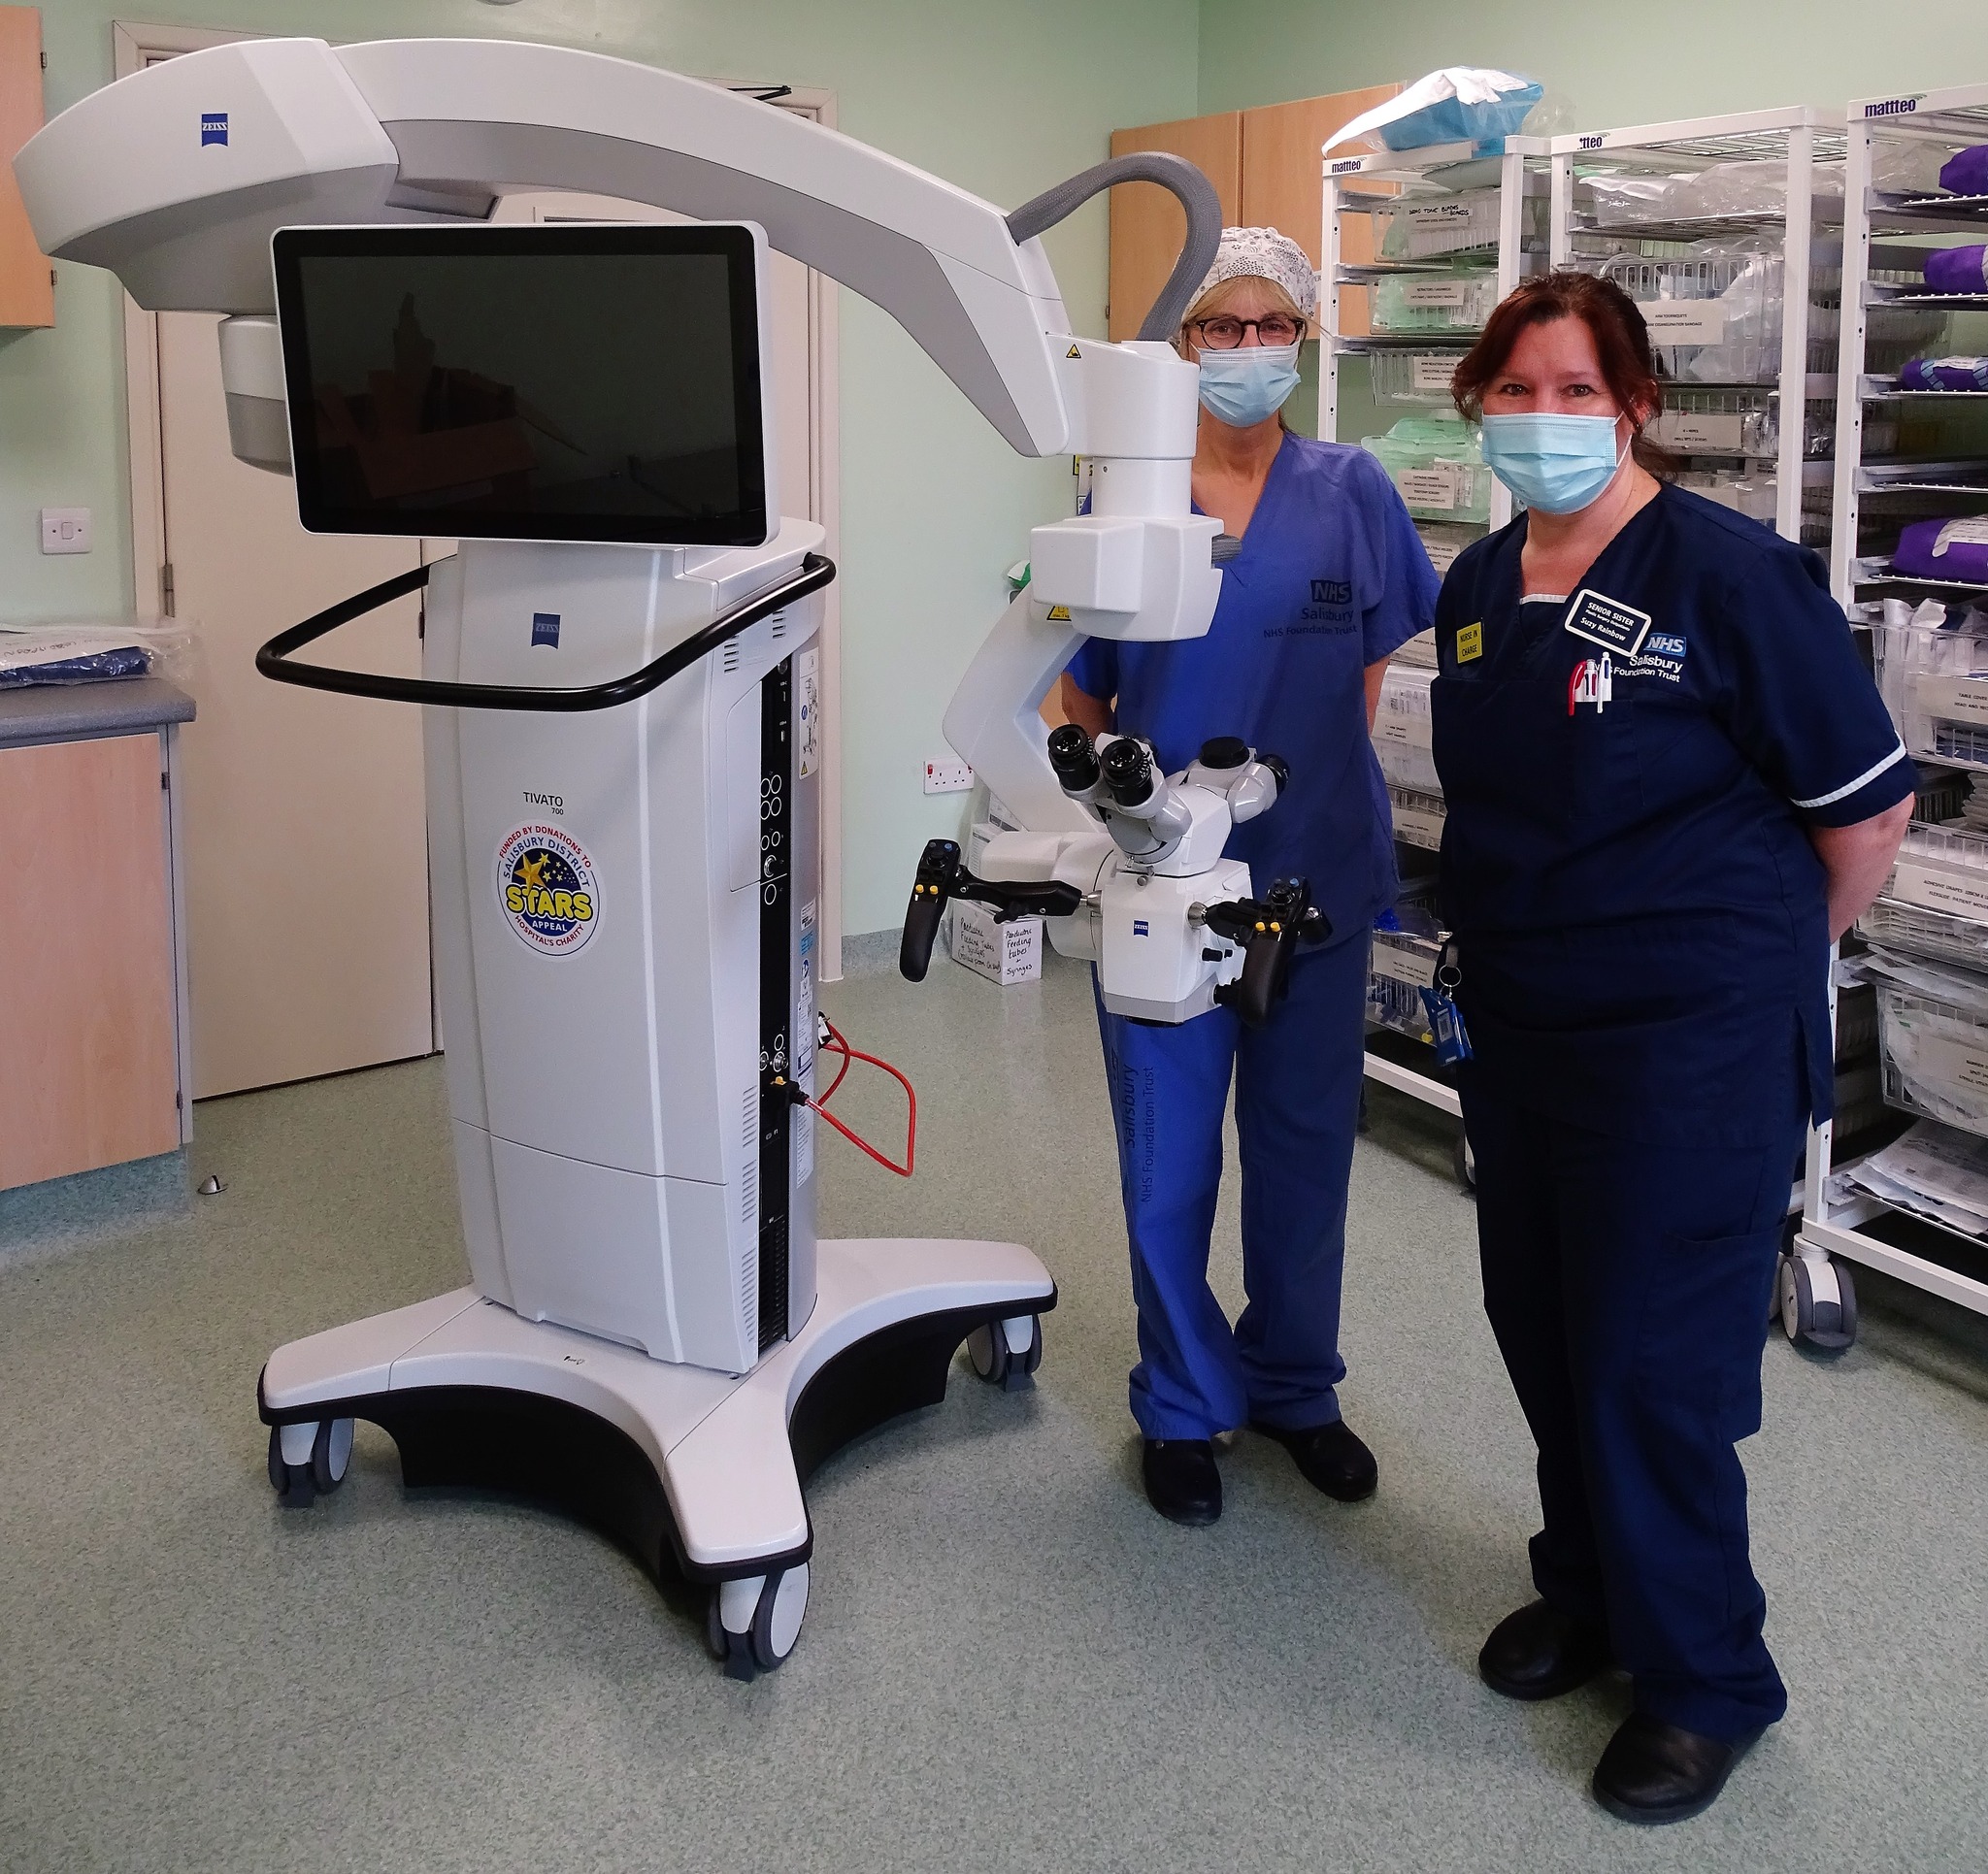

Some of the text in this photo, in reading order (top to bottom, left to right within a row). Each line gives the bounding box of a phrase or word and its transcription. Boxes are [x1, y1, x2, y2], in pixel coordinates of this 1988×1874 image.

[1865, 99, 1916, 117] mattteo
[203, 122, 228, 131] ZEISS
[1332, 160, 1362, 174] mattteo
[1313, 582, 1350, 603] NHS
[1301, 608, 1354, 623] Salisbury
[1587, 602, 1635, 627] SENIOR SISTER
[535, 622, 560, 633] ZEISS
[1264, 628, 1284, 639] NHS
[1335, 624, 1358, 636] Trust
[1580, 616, 1627, 641] Suzy Rainbow
[1460, 631, 1473, 642] NURSE
[1462, 643, 1477, 657] CHARGE
[1647, 637, 1685, 653] NHS
[1630, 654, 1683, 674] Salisbury
[1613, 666, 1655, 676] Foundation
[1657, 669, 1680, 682] Trust
[523, 791, 563, 807] TIVATO
[499, 825, 591, 869] FUNDED BY DONATIONS TO
[503, 837, 590, 887] SALISBURY DISTRICT
[506, 884, 593, 922] STARS
[514, 914, 584, 946] HOSPITAL'S CHARITY
[532, 920, 568, 932] APPEAL
[1007, 937, 1032, 949] Feeding
[1009, 947, 1027, 959] tubes
[1124, 1064, 1140, 1149] Salisbury
[1142, 1067, 1155, 1202] NHS Foundation Trust
